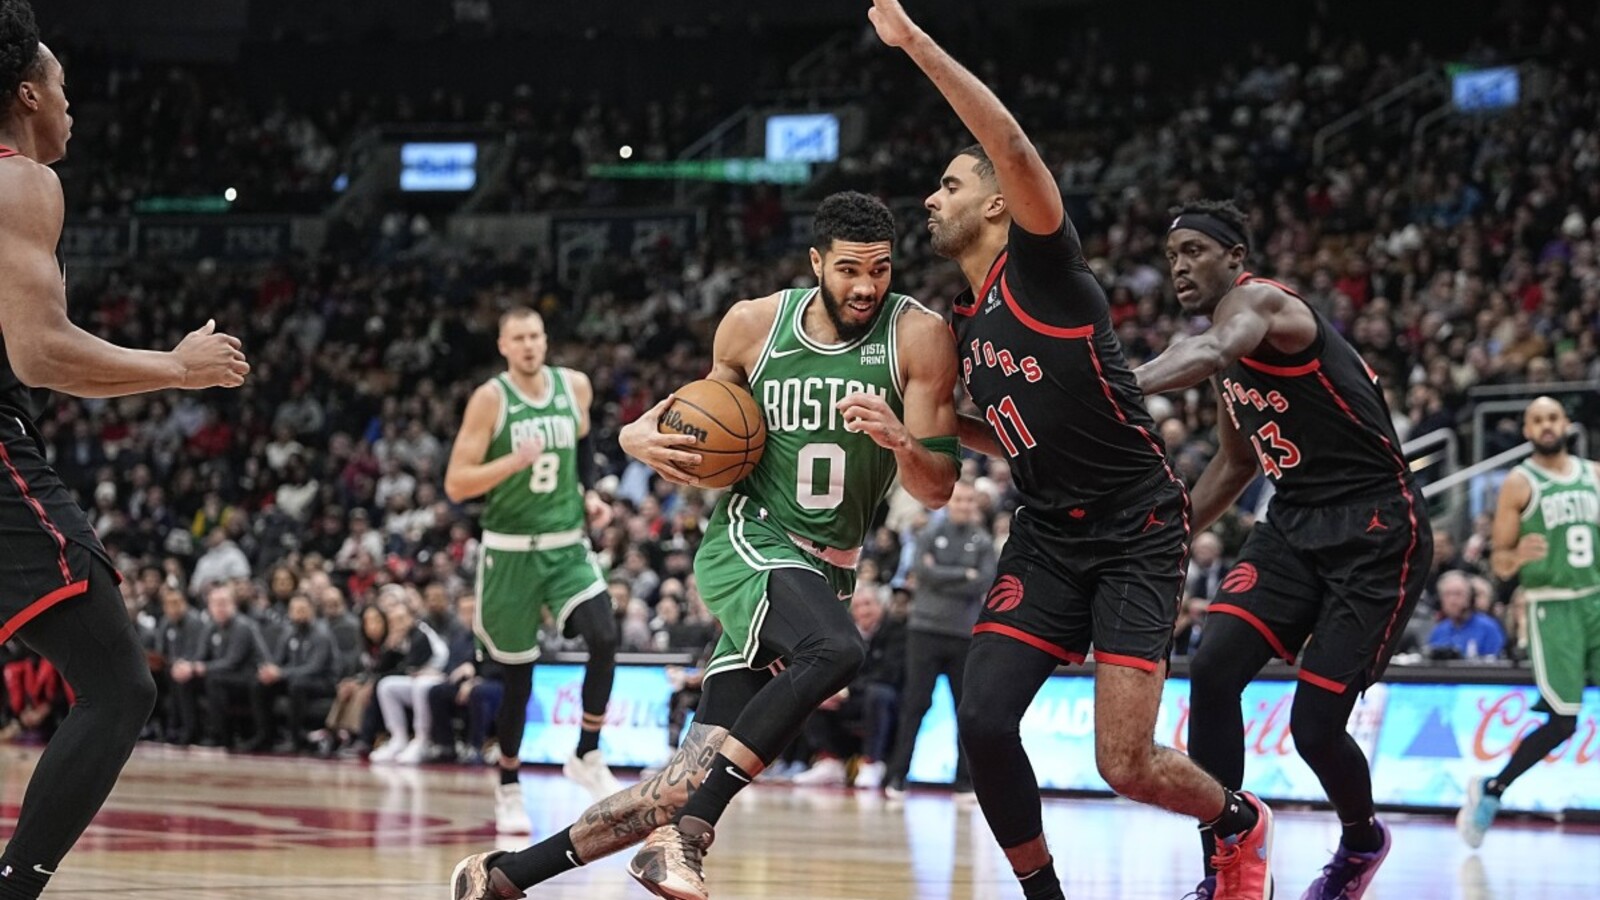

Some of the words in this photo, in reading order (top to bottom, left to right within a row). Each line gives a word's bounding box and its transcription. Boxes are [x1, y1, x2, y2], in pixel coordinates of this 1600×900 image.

[860, 343, 886, 356] VISTA
[860, 356, 886, 365] PRINT
[962, 338, 1043, 385] PTORS
[986, 395, 1037, 458] 11
[1250, 420, 1301, 480] 43
[529, 452, 560, 494] 8
[796, 443, 846, 510] 0
[1566, 525, 1594, 568] 9
